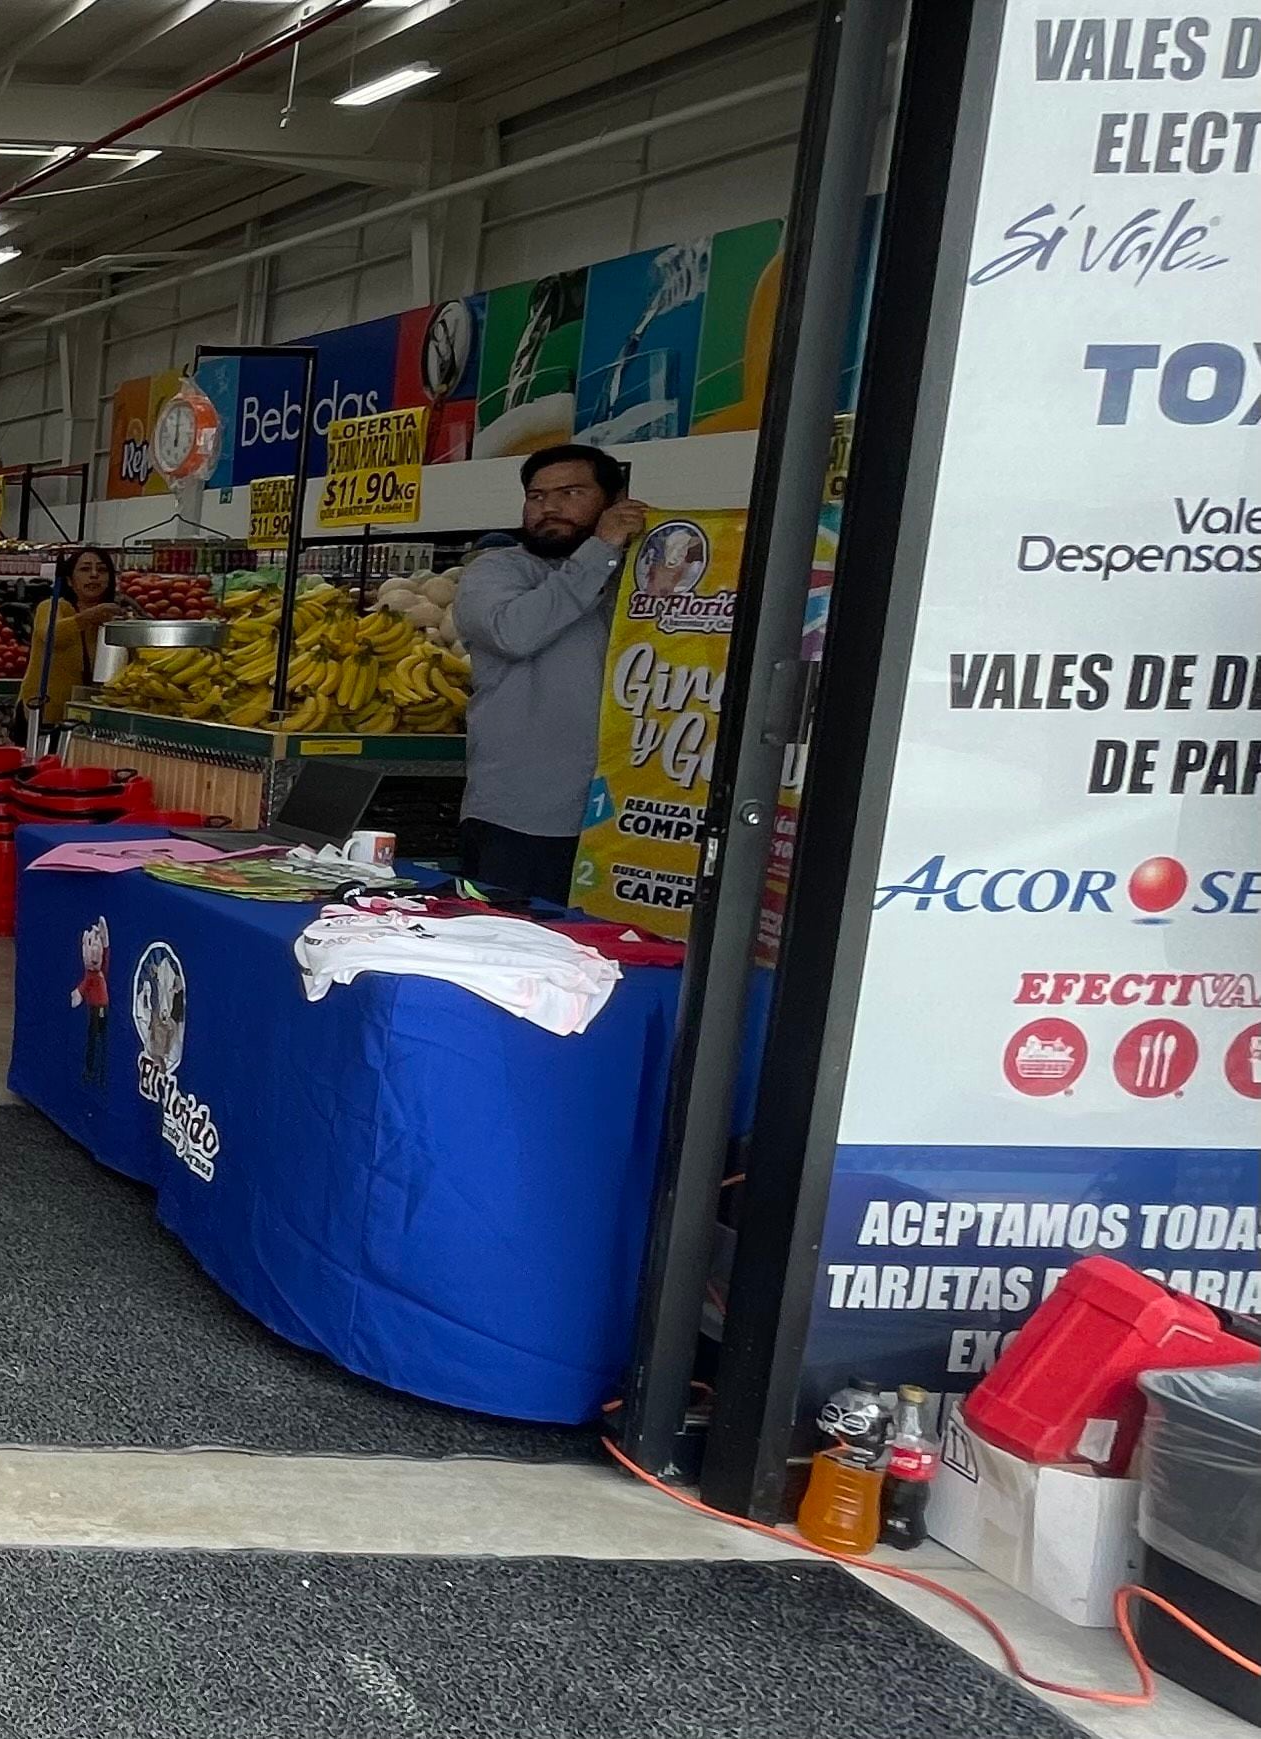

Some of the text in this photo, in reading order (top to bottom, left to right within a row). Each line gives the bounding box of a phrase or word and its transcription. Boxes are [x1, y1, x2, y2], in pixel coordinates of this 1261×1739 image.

[1035, 16, 1210, 82] VALES
[1093, 110, 1261, 175] ELECT
[241, 379, 379, 447] Bebdas
[343, 412, 418, 440] OFERTA
[1173, 497, 1261, 535] Vale
[1017, 535, 1261, 581] Despensas
[631, 594, 657, 616] El
[949, 653, 1114, 711] VALES
[1125, 654, 1199, 711] DE
[631, 717, 664, 766] y
[1088, 739, 1161, 795] DE
[592, 793, 607, 817] 1
[624, 797, 690, 821] REALIZA
[576, 864, 596, 887] 2
[612, 864, 652, 880] BUSCA
[874, 855, 1117, 913] ACCOR
[1012, 973, 1261, 1006] EFECTIVA
[858, 1200, 1261, 1252] ACEPTAMOS TODA
[827, 1264, 1035, 1312] TARJETAS
